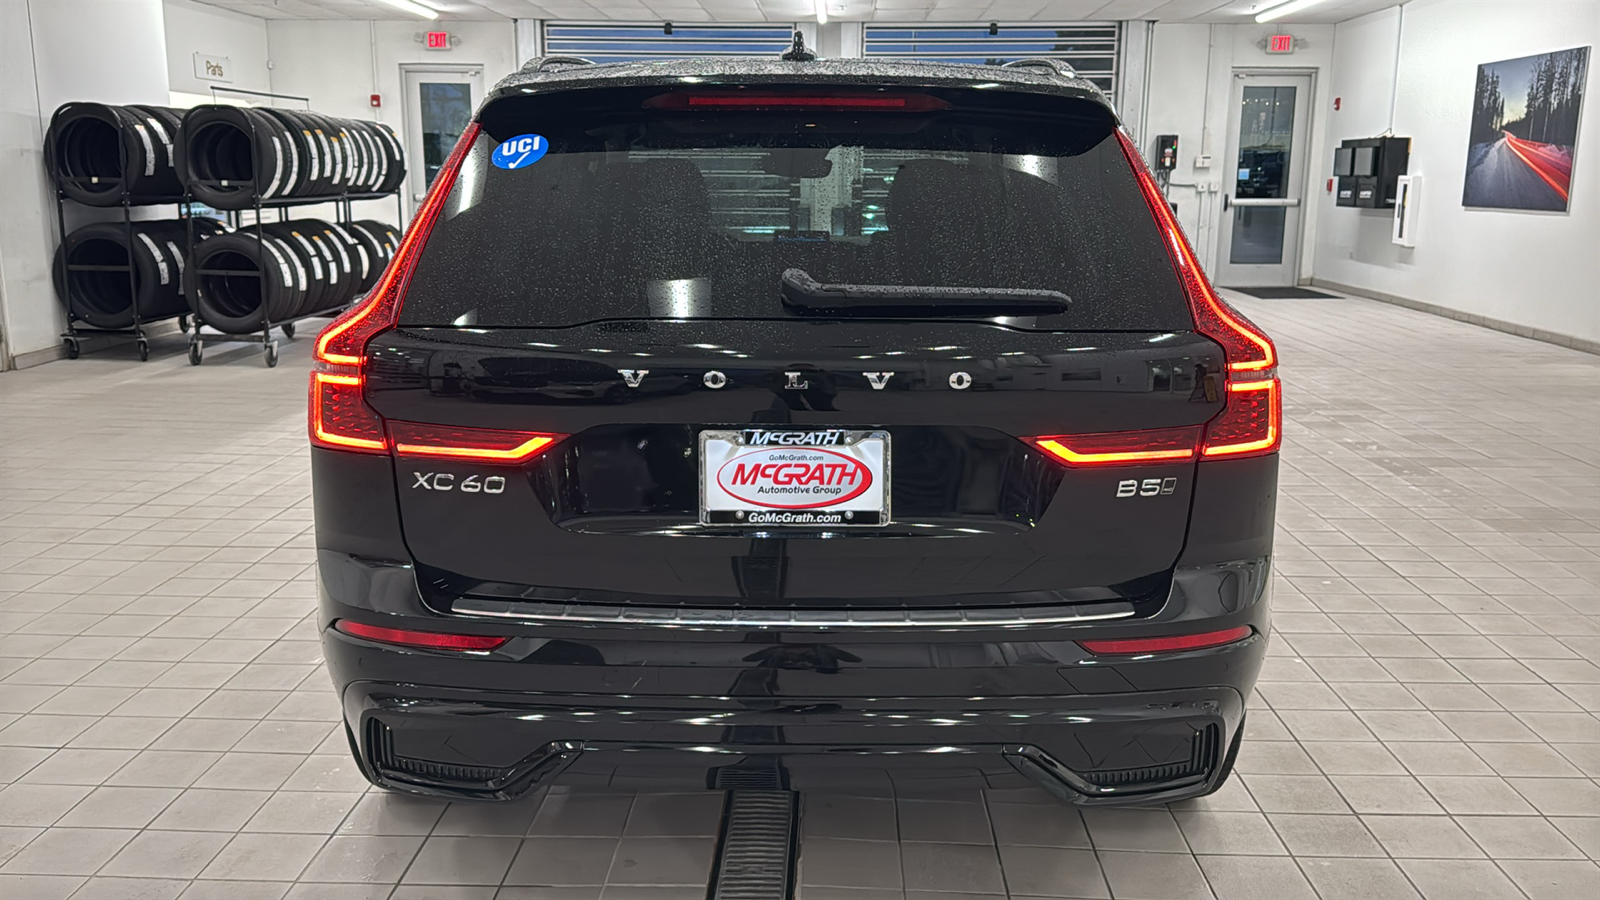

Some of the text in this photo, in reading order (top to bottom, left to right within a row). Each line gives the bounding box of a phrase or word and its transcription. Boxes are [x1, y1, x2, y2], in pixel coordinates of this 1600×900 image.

[428, 31, 447, 48] EXIT
[1271, 35, 1292, 51] EXIT
[502, 136, 540, 156] UCI
[618, 369, 972, 390] VOLVO
[768, 454, 824, 462] GoMcGrath.com
[757, 486, 842, 496] Automotive Group
[748, 512, 842, 523] GoMcGrath.com
